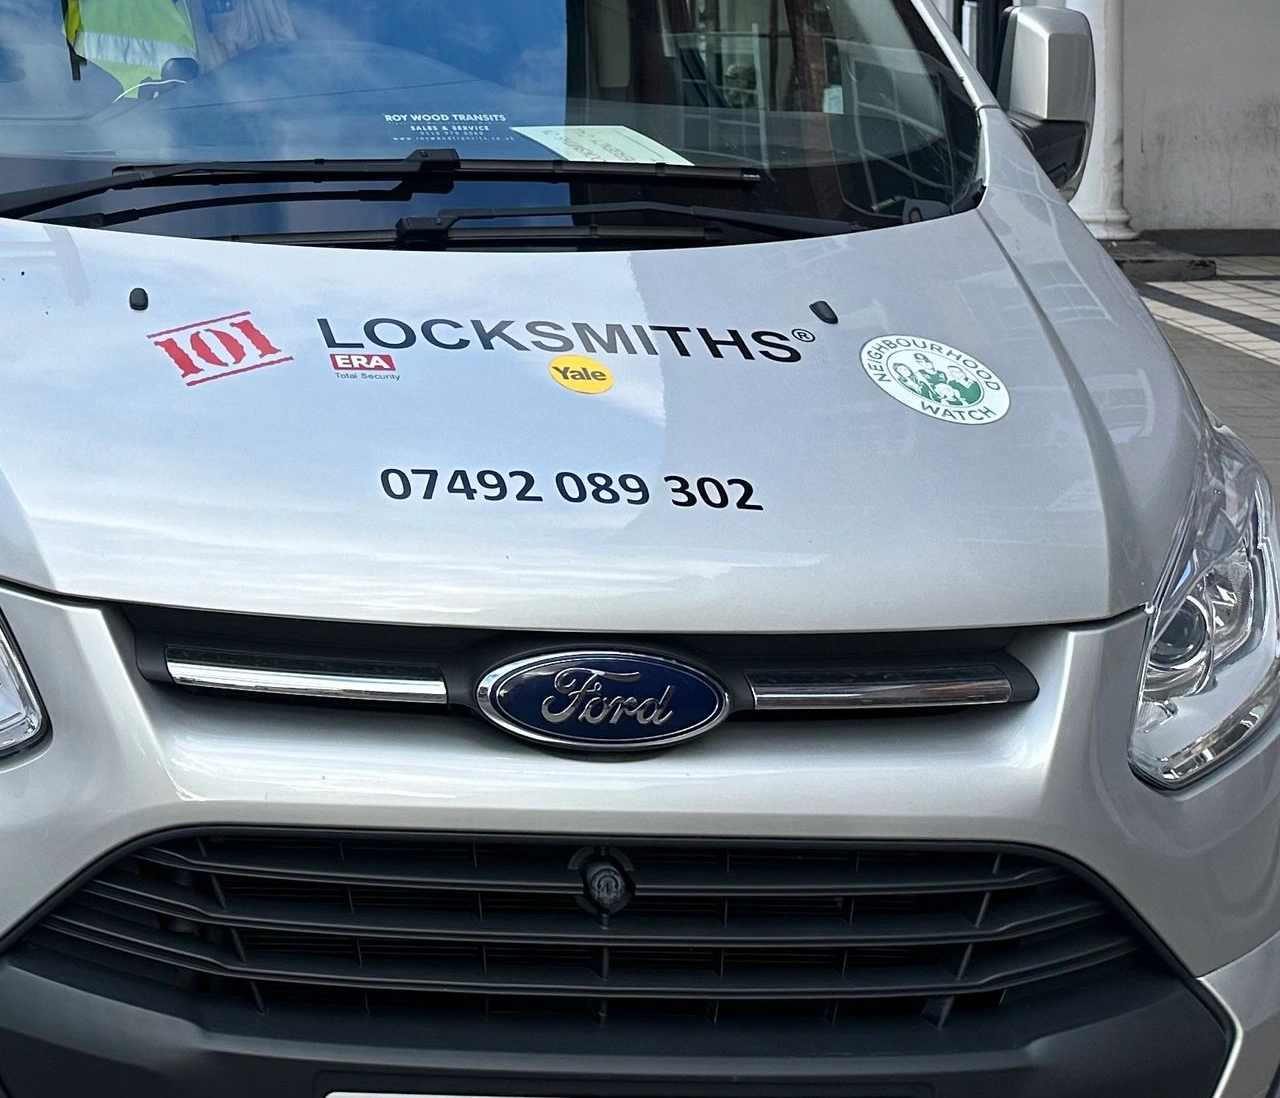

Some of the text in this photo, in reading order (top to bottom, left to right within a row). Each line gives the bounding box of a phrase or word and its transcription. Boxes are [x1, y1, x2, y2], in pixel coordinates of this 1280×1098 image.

[384, 114, 507, 122] ROY WOOD TRANSITS
[154, 319, 282, 379] 101
[334, 354, 391, 370] ERA
[866, 338, 1001, 391] NEIGHBOURHOOD
[335, 372, 401, 381] Total Security
[552, 365, 608, 384] Yale
[920, 401, 997, 421] WATCH
[380, 468, 763, 511] 07492 089 302
[541, 667, 674, 725] Ford
